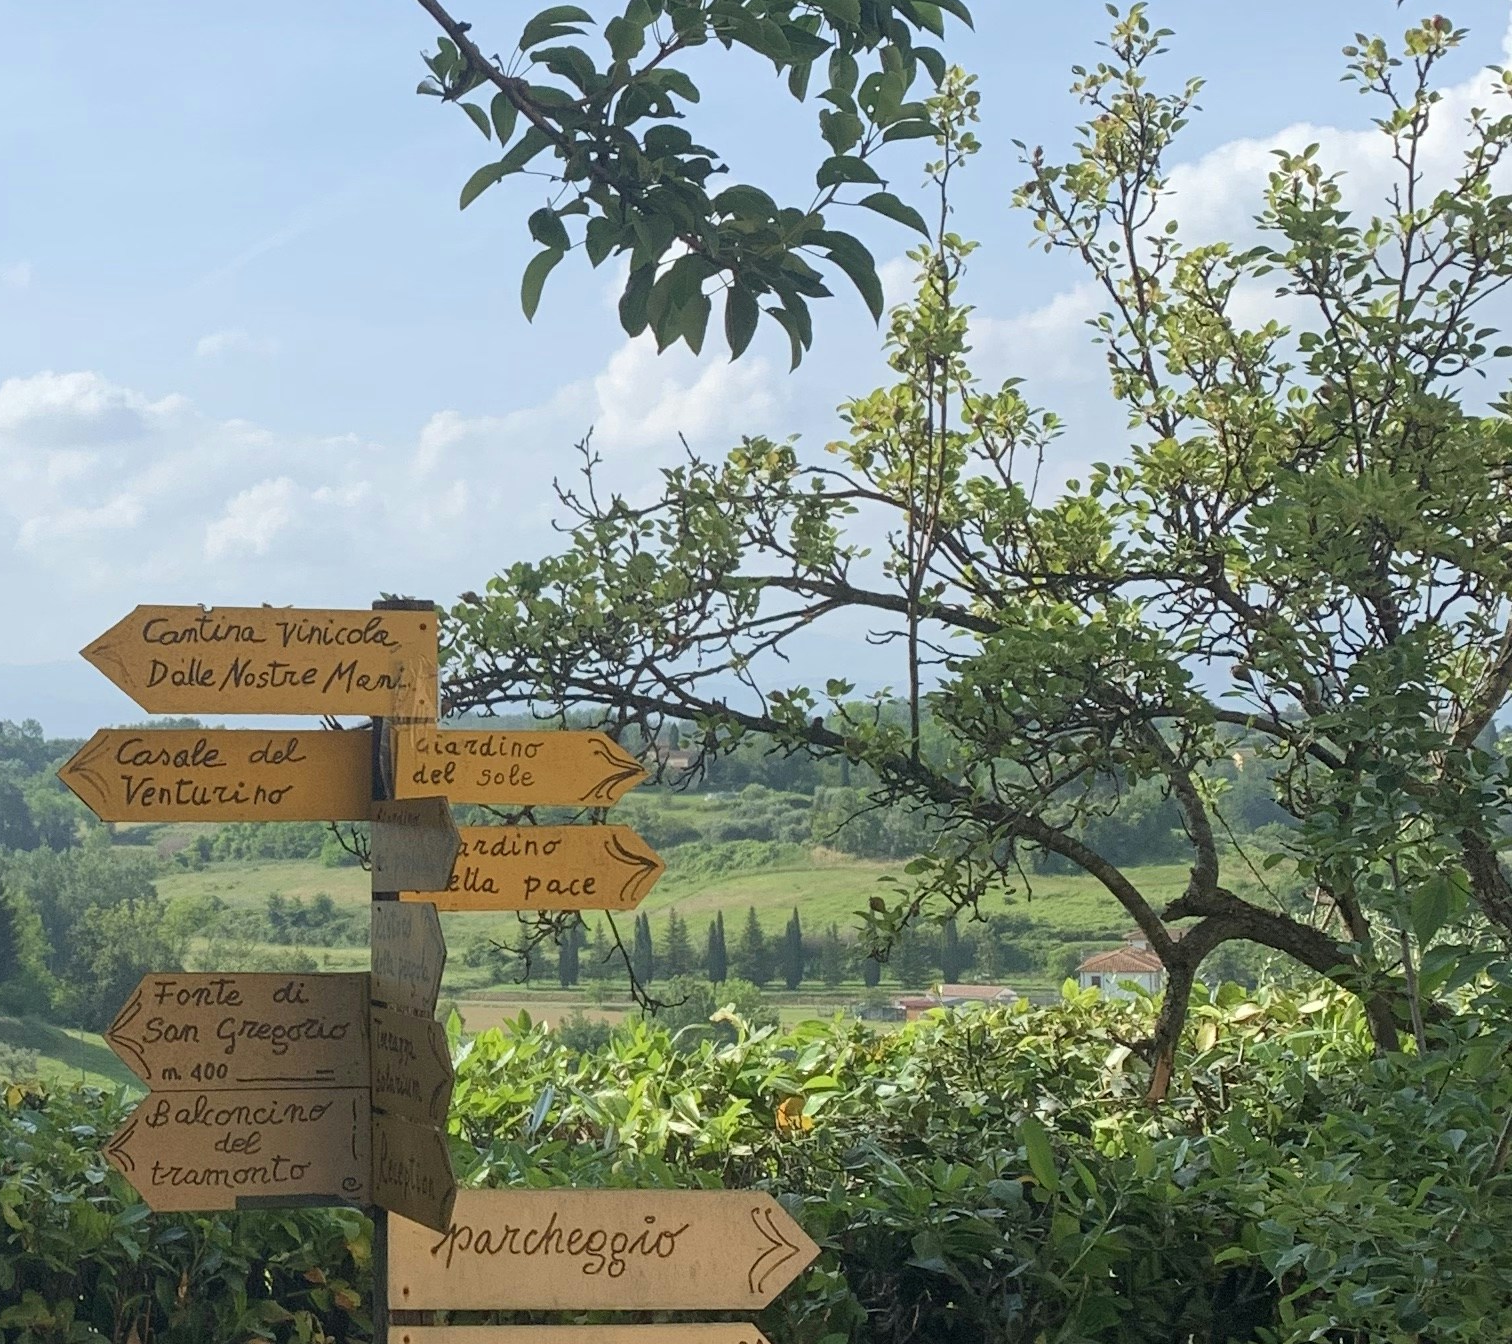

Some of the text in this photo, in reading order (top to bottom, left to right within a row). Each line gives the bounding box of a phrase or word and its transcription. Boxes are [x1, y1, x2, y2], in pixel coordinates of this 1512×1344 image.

[142, 615, 266, 646] Cantina
[146, 657, 216, 688] Dalle
[218, 657, 318, 691] Nostre
[116, 737, 306, 768] Casale del
[416, 734, 544, 758] Giardino
[412, 761, 535, 787] del sole
[121, 775, 294, 806] Venturino
[456, 834, 562, 857] ardino
[449, 867, 596, 900] ella pace
[154, 978, 309, 1007] Fonte di
[142, 1016, 350, 1054] San Gregorio
[190, 1062, 228, 1082] 400
[145, 1094, 334, 1128] Balconcino
[214, 1132, 262, 1155] del
[150, 1156, 312, 1187] tramonto
[430, 1212, 689, 1277] parcheggio
